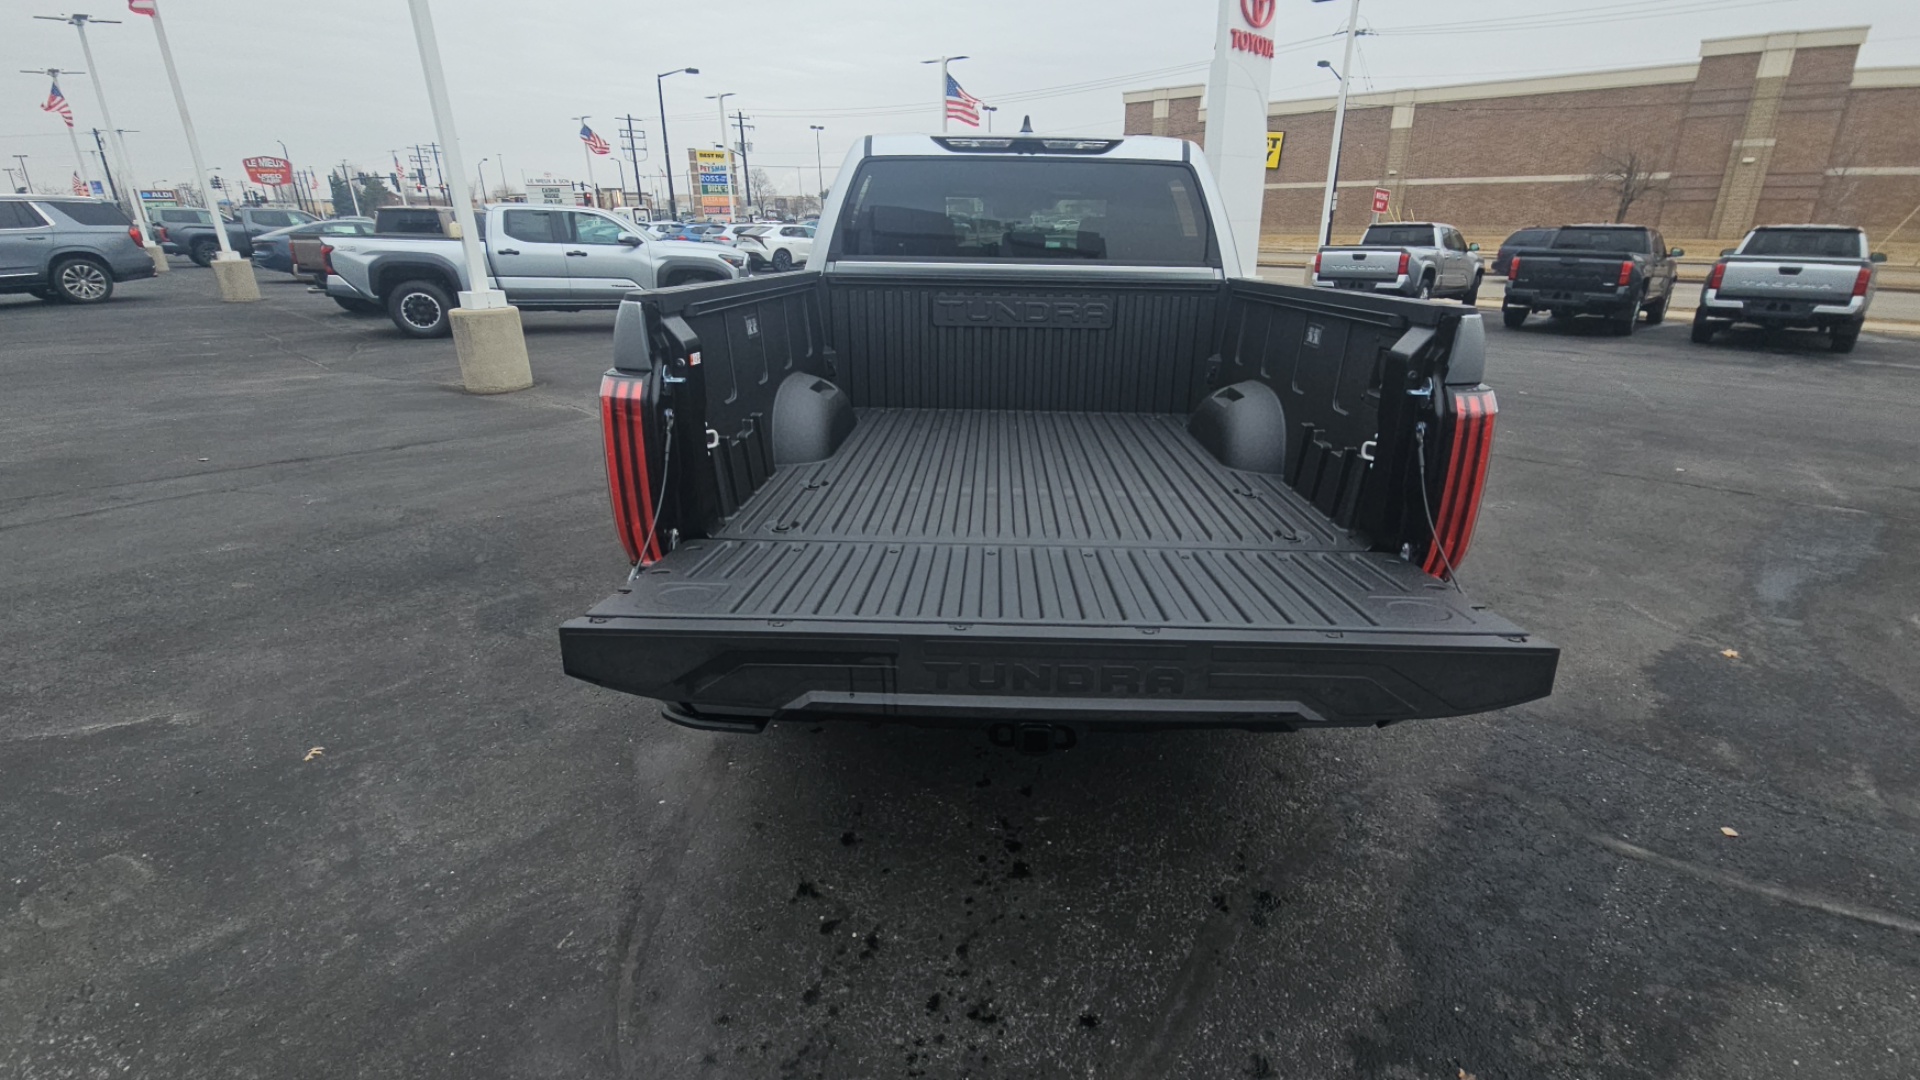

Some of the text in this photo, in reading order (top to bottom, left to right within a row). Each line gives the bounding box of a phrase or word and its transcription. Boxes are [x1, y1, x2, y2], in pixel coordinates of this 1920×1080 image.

[1230, 28, 1274, 59] TOYOTA
[1741, 280, 1833, 290] TACOMA
[937, 300, 1110, 324] TUNDRA
[921, 660, 1187, 695] TUNDRA
